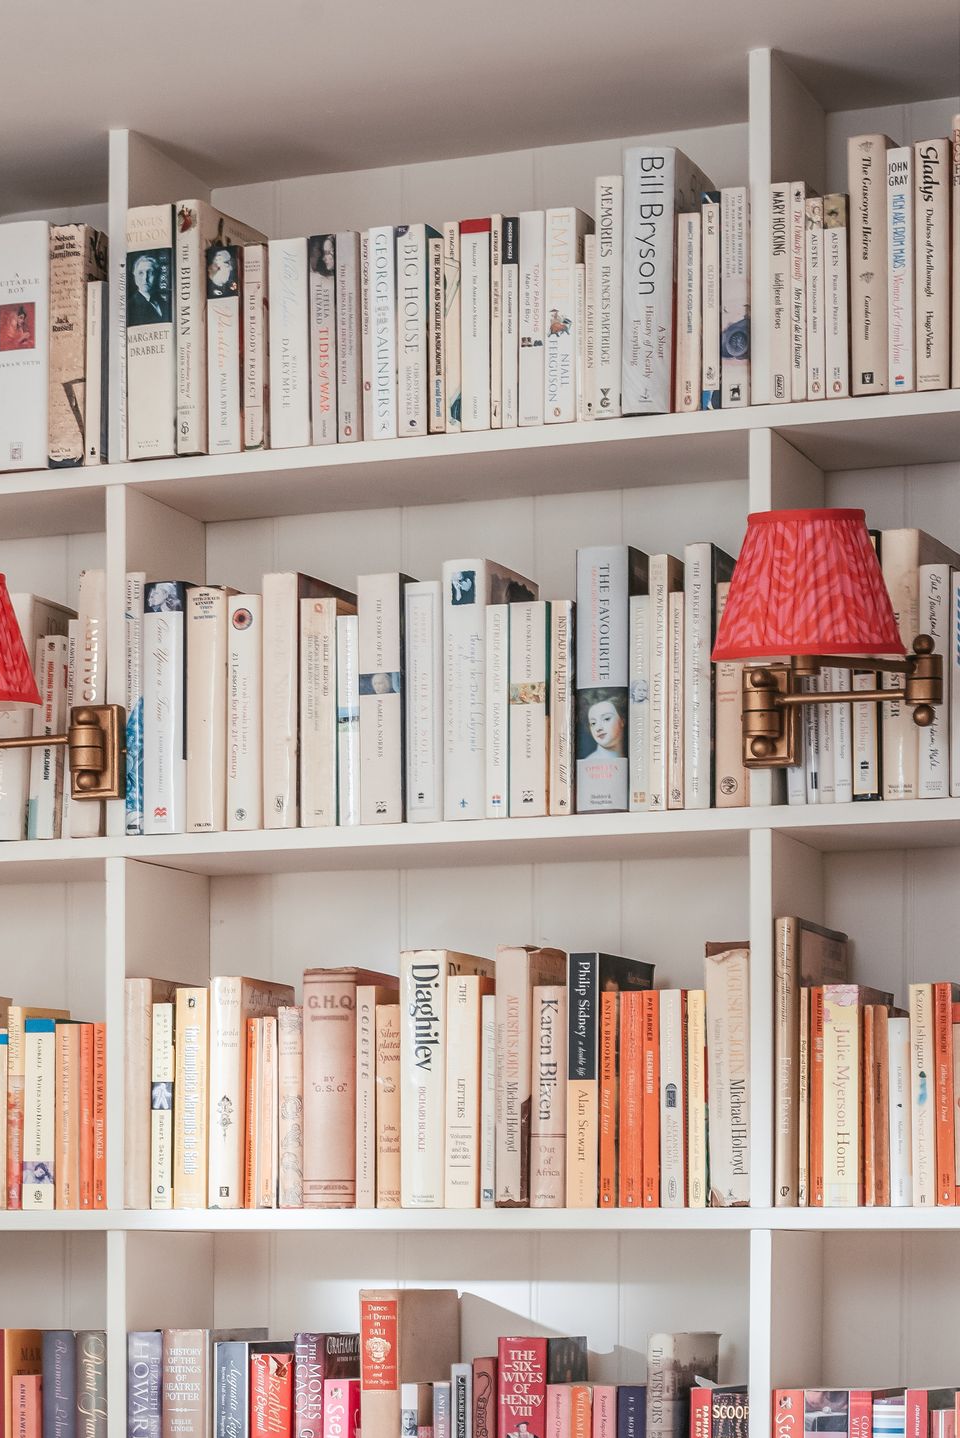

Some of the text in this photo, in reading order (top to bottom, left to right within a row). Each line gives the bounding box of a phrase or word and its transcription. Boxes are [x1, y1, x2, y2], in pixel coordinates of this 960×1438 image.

[888, 162, 908, 175] JOHN
[919, 147, 940, 202] Gladys
[599, 186, 612, 258] MEMORIES
[634, 157, 664, 295] Bill Bryson
[772, 191, 785, 256] MARY HOCKING
[860, 157, 871, 261] The Gascoyne Heiress
[180, 267, 190, 301] BIRD
[404, 244, 418, 354] BIG HOUSE
[181, 307, 190, 336] MAN
[374, 234, 390, 418] GEORGE SAUNDERS
[632, 320, 640, 366] Everything
[643, 305, 653, 379] History of Nearly
[318, 327, 330, 413] TIDES of WAR
[599, 564, 610, 680] THE FAVOURITE
[410, 964, 440, 1072] Diaghilev
[575, 962, 590, 1037] Philip Sidney
[539, 999, 558, 1120] Karen Blixen
[577, 1090, 588, 1161] Alan Stewart
[729, 1080, 747, 1176] Michael Holroyd
[833, 1026, 850, 1176] Julie Myerson Home
[502, 1371, 543, 1382] WIVES
[509, 1350, 536, 1361] THE
[514, 1385, 530, 1394] OF
[501, 1395, 544, 1407] HENRY
[511, 1406, 533, 1416] VIII
